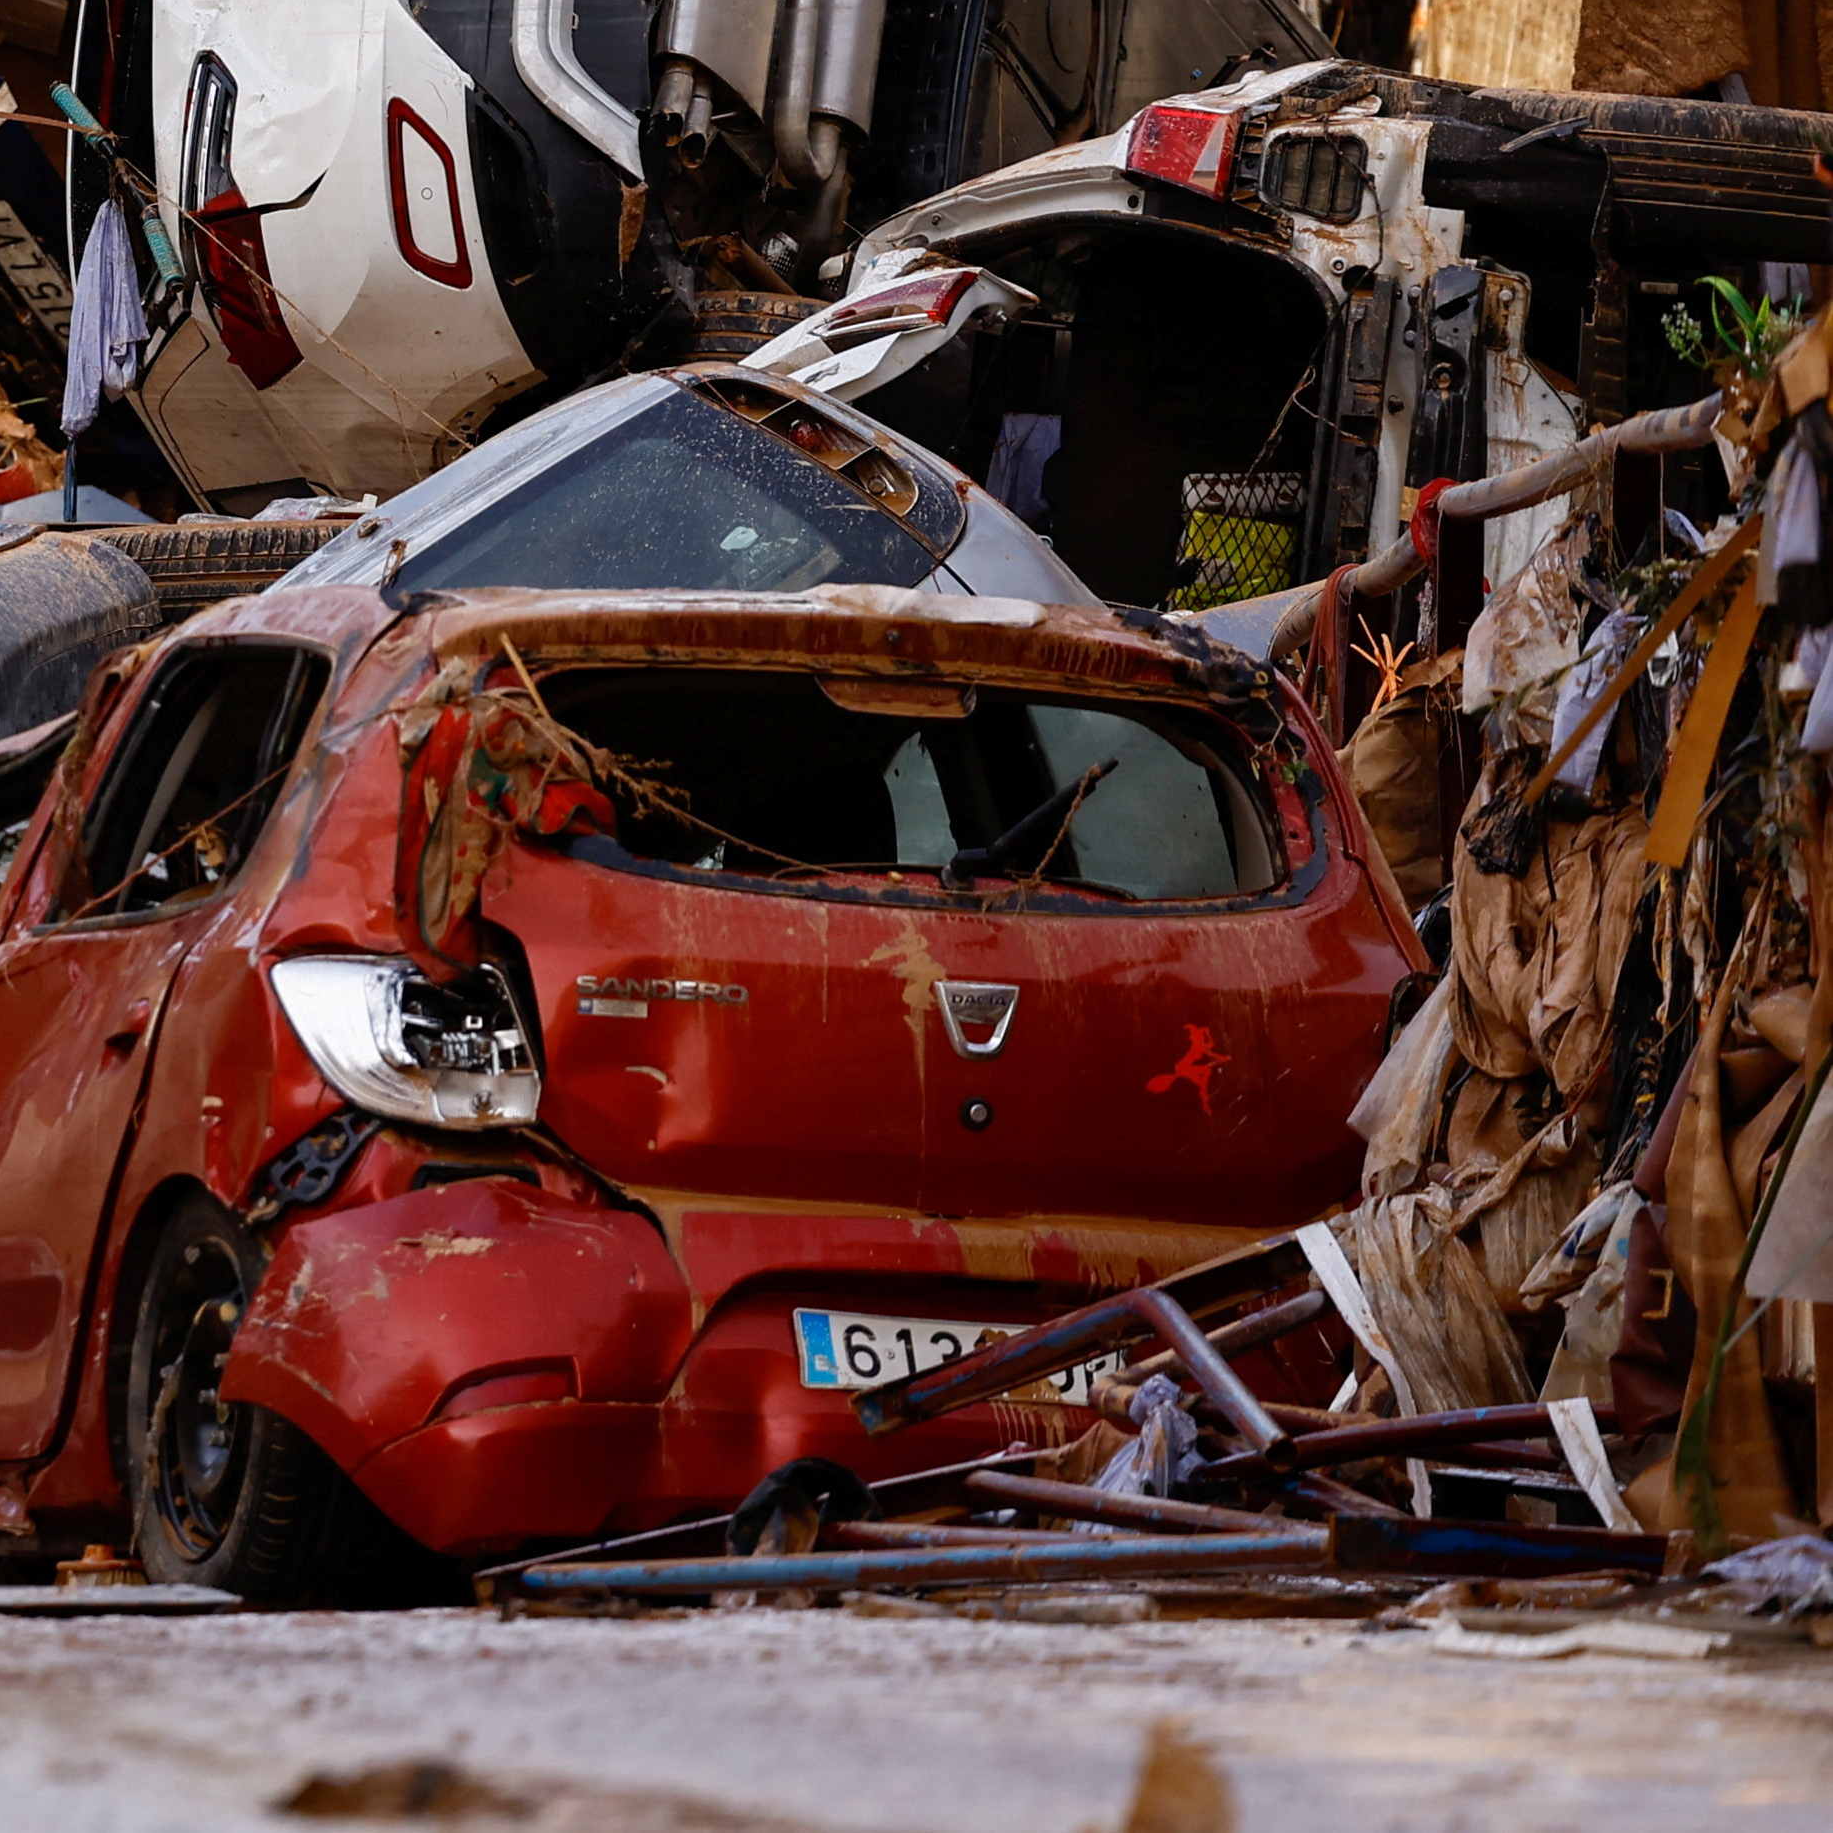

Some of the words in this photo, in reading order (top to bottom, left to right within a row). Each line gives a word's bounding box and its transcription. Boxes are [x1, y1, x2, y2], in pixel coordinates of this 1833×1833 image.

[576, 974, 750, 1004] SANDERO
[951, 993, 1007, 1006] DACIA
[842, 1321, 1010, 1379] 613
